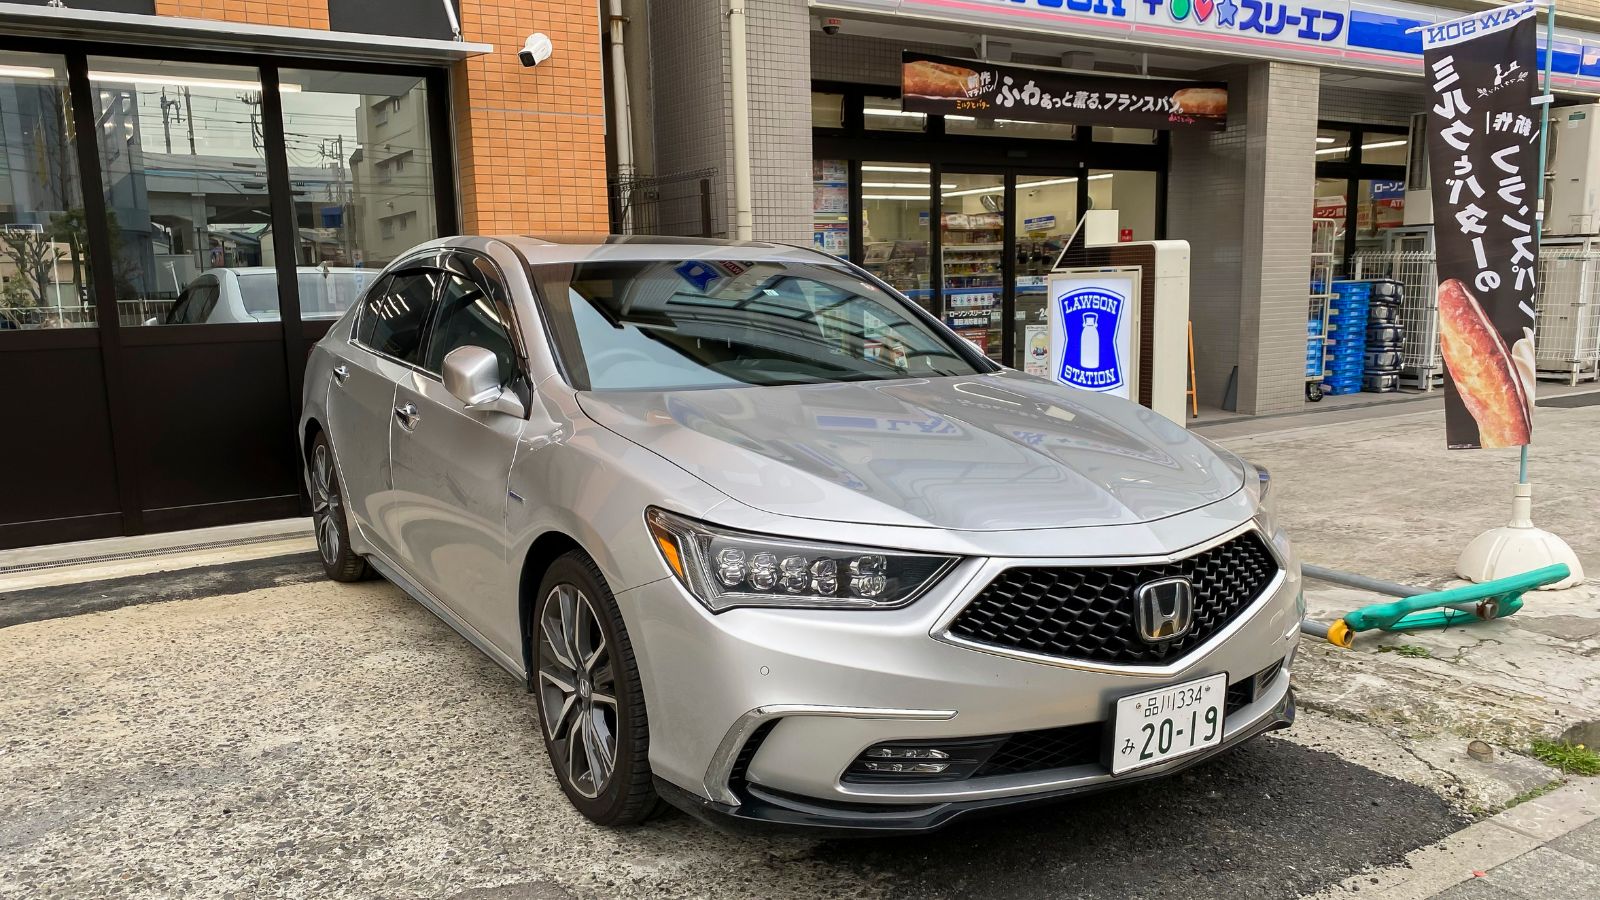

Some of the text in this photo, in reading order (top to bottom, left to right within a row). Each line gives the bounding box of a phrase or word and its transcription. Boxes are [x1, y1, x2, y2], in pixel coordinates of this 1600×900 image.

[1239, 0, 1345, 42] スリーエフ
[1064, 294, 1118, 315] LAWSON
[1064, 364, 1116, 385] STATION
[1121, 705, 1218, 762] み 20-19
